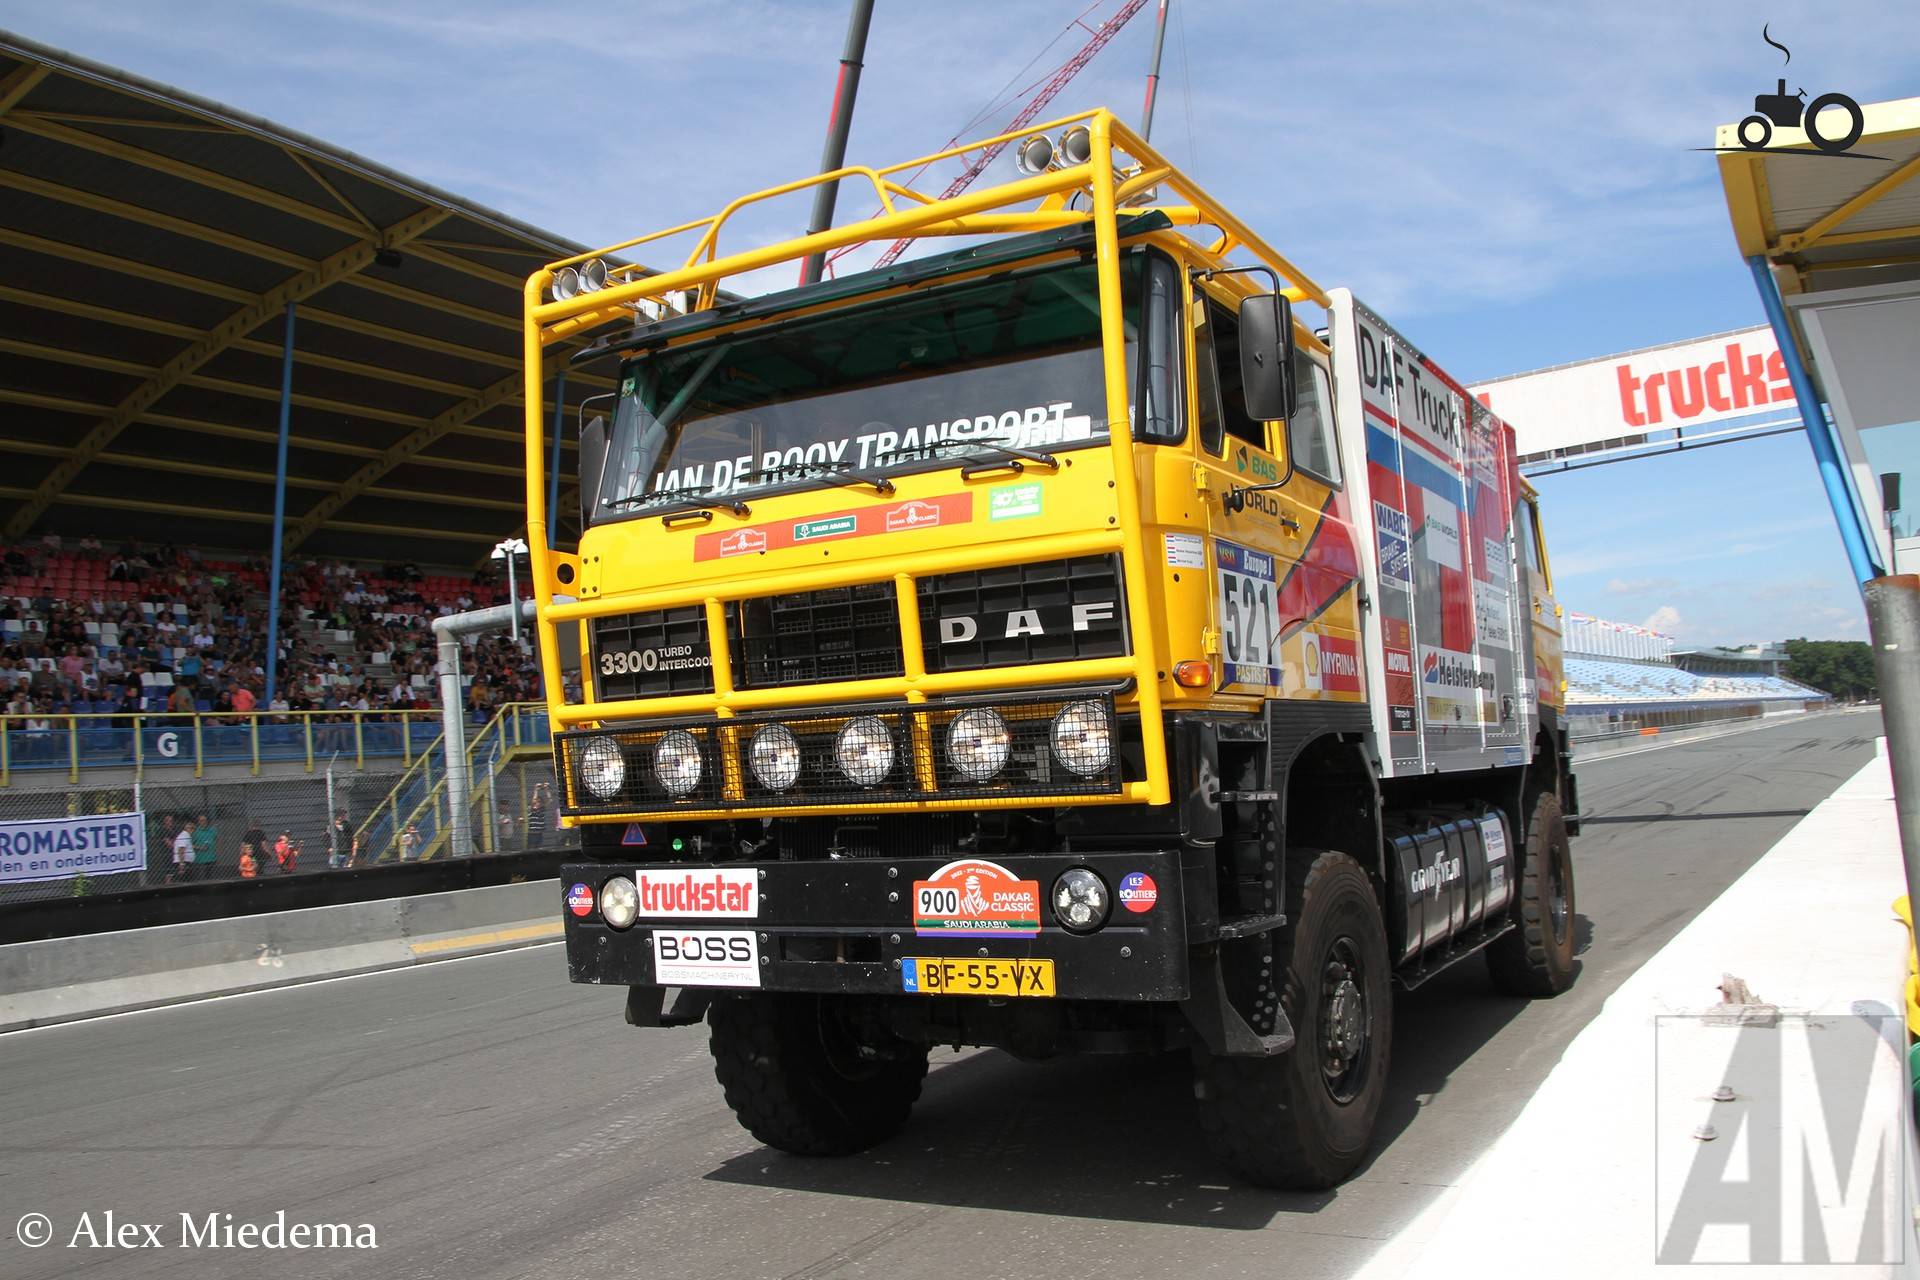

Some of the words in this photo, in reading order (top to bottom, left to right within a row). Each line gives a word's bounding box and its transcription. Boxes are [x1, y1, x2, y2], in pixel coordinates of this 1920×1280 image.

[1359, 323, 1404, 406] DAF
[1616, 343, 1796, 427] trucks
[712, 455, 752, 492] DE
[759, 439, 849, 485] ROOY
[856, 402, 1073, 469] TRANSPORT
[1252, 455, 1277, 481] BAS
[1233, 487, 1278, 516] ORLD
[1243, 550, 1268, 578] Europe
[940, 602, 1114, 643] DAF
[1223, 573, 1273, 664] 521
[601, 649, 657, 675] 3300
[658, 645, 692, 657] TURBO
[1321, 651, 1356, 676] MYRINA
[157, 732, 179, 757] G
[30, 860, 49, 870] en
[55, 849, 136, 868] onderhoud
[641, 874, 752, 911] truckstar
[1119, 889, 1157, 899] ROUTIERS
[1129, 877, 1143, 886] LES
[921, 890, 957, 913] 900
[991, 902, 1034, 912] CLASSIC
[993, 892, 1032, 902] DAKAR
[943, 920, 973, 929] SAUDI
[974, 921, 1011, 929] ARABIA
[659, 936, 751, 961] BOSS
[906, 978, 917, 986] NL
[926, 964, 1044, 991] BF-55-VX
